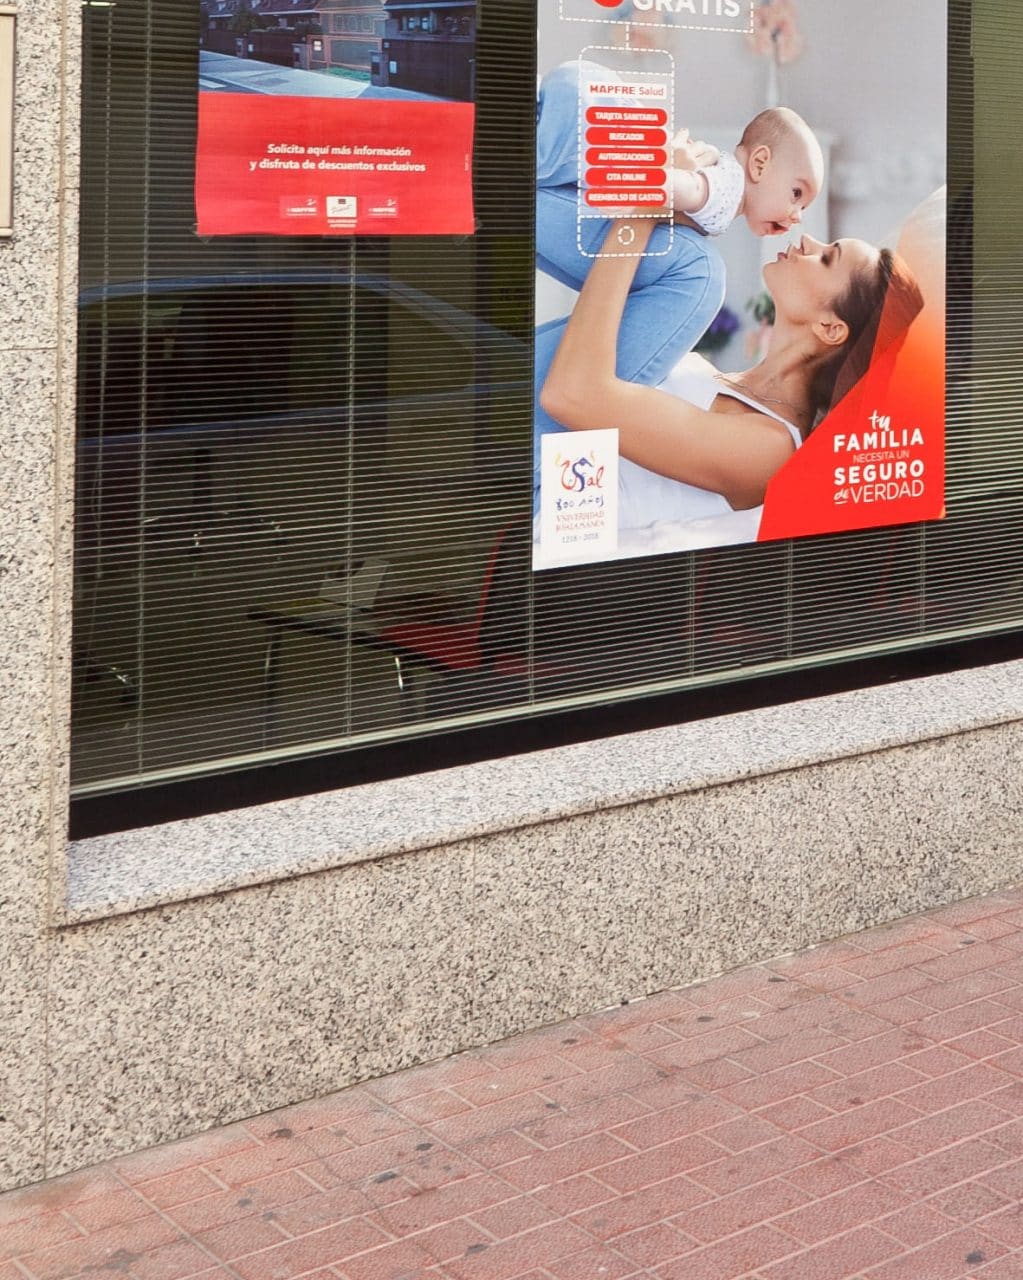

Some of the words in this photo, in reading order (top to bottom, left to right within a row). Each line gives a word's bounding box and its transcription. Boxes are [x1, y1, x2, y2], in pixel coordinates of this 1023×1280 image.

[590, 84, 635, 95] MAPFRE
[639, 85, 664, 97] Salud
[266, 143, 305, 155] Solicita
[307, 145, 330, 158] aquí
[331, 145, 351, 156] más
[353, 145, 412, 157] información
[250, 160, 257, 171] y
[259, 158, 299, 170] disfruta
[302, 160, 316, 170] de
[318, 160, 373, 171] descuentos
[376, 161, 427, 173] exclusivos
[868, 409, 891, 432] tu
[833, 427, 925, 453] FAMILIA
[853, 451, 895, 463] NECESITA
[896, 450, 911, 460] UN
[833, 459, 924, 486] SEGURO
[850, 479, 924, 504] VERDAD
